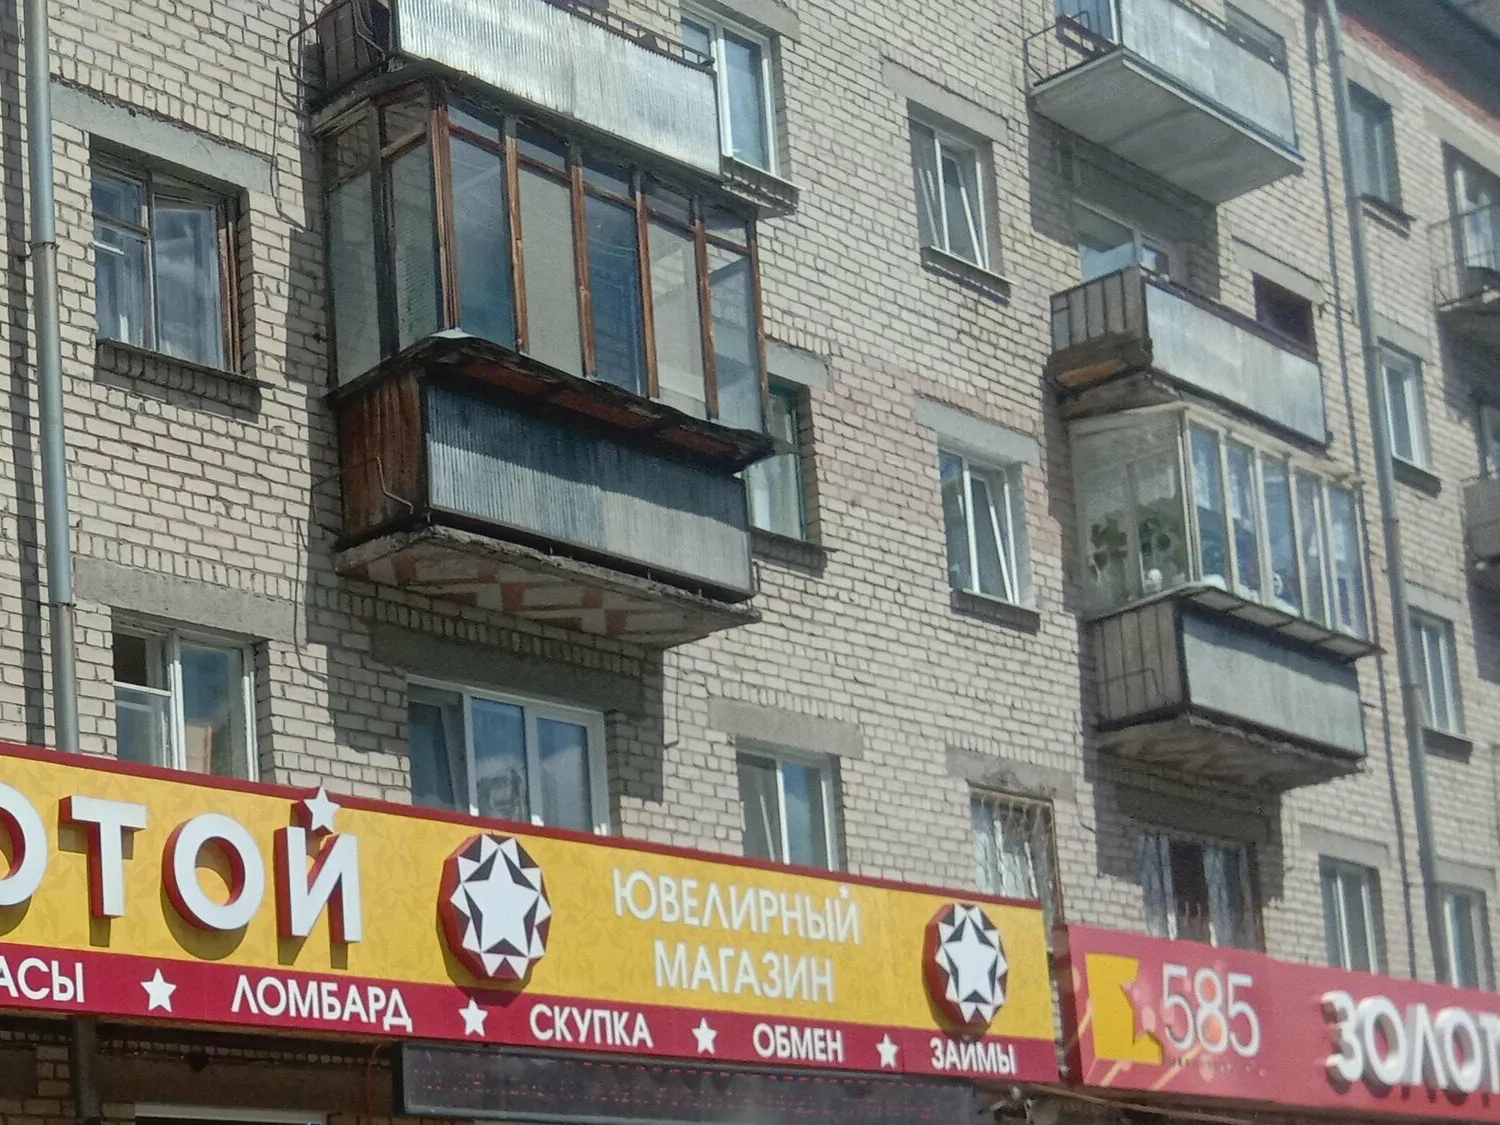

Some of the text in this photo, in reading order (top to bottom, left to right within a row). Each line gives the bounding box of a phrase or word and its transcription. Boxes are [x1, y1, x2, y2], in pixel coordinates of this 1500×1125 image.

[613, 869, 860, 945] ЮВЕЛИРНЫЙ
[655, 941, 835, 1004] МАГАЗИН
[231, 974, 413, 1034] ЛОМБАРД
[530, 1004, 654, 1049] СКУПКА
[1162, 963, 1260, 1058] 585
[753, 1023, 844, 1063] ОБМЕН
[930, 1038, 1017, 1075] ЗАЙМЫ
